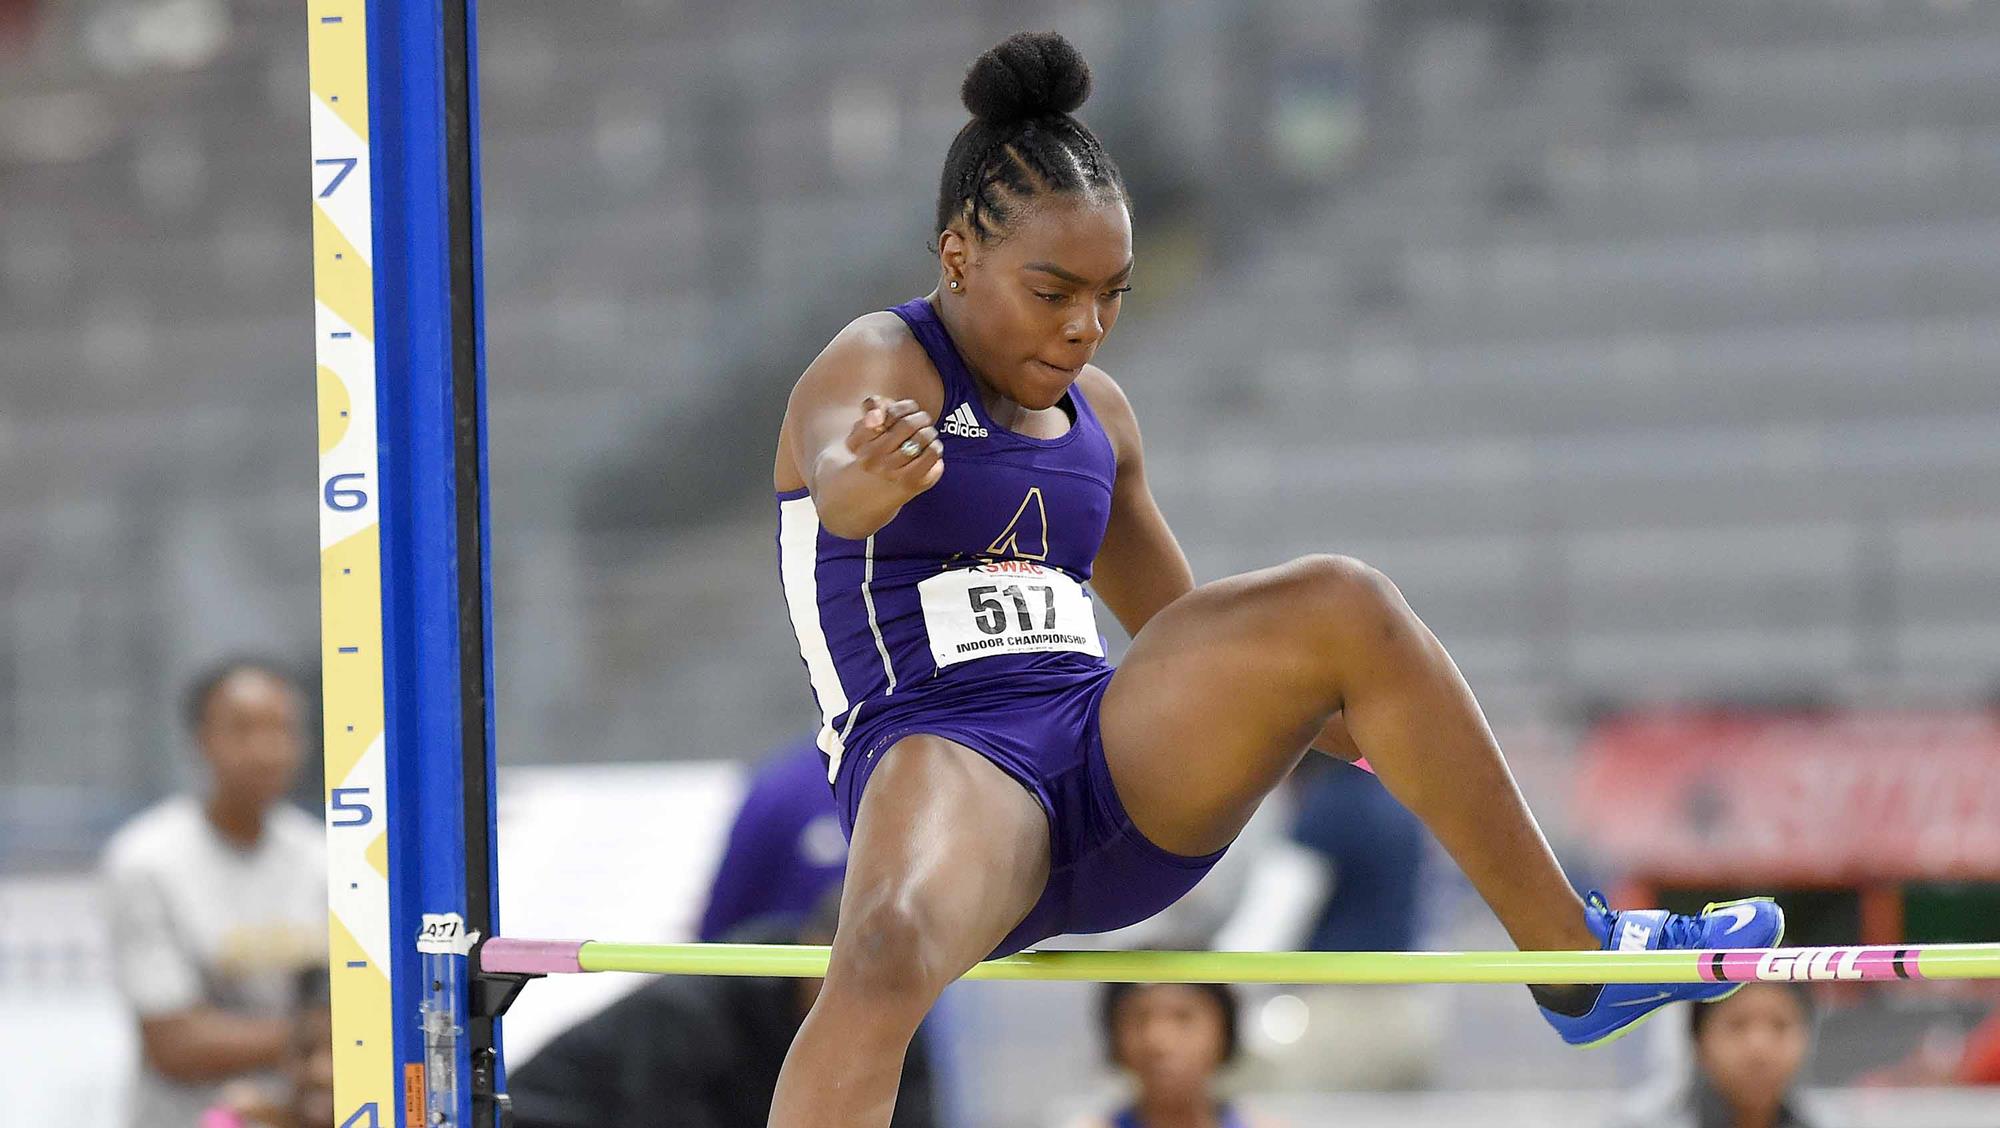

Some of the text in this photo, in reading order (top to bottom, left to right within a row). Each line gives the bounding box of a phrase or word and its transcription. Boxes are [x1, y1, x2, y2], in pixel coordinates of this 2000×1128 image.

[316, 158, 358, 198] 7
[323, 473, 368, 512] 6
[986, 560, 1044, 575] SWAC
[968, 585, 1056, 635] 517
[956, 637, 1004, 654] INDOOR
[331, 788, 373, 827] 5
[1756, 950, 1863, 980] GILL
